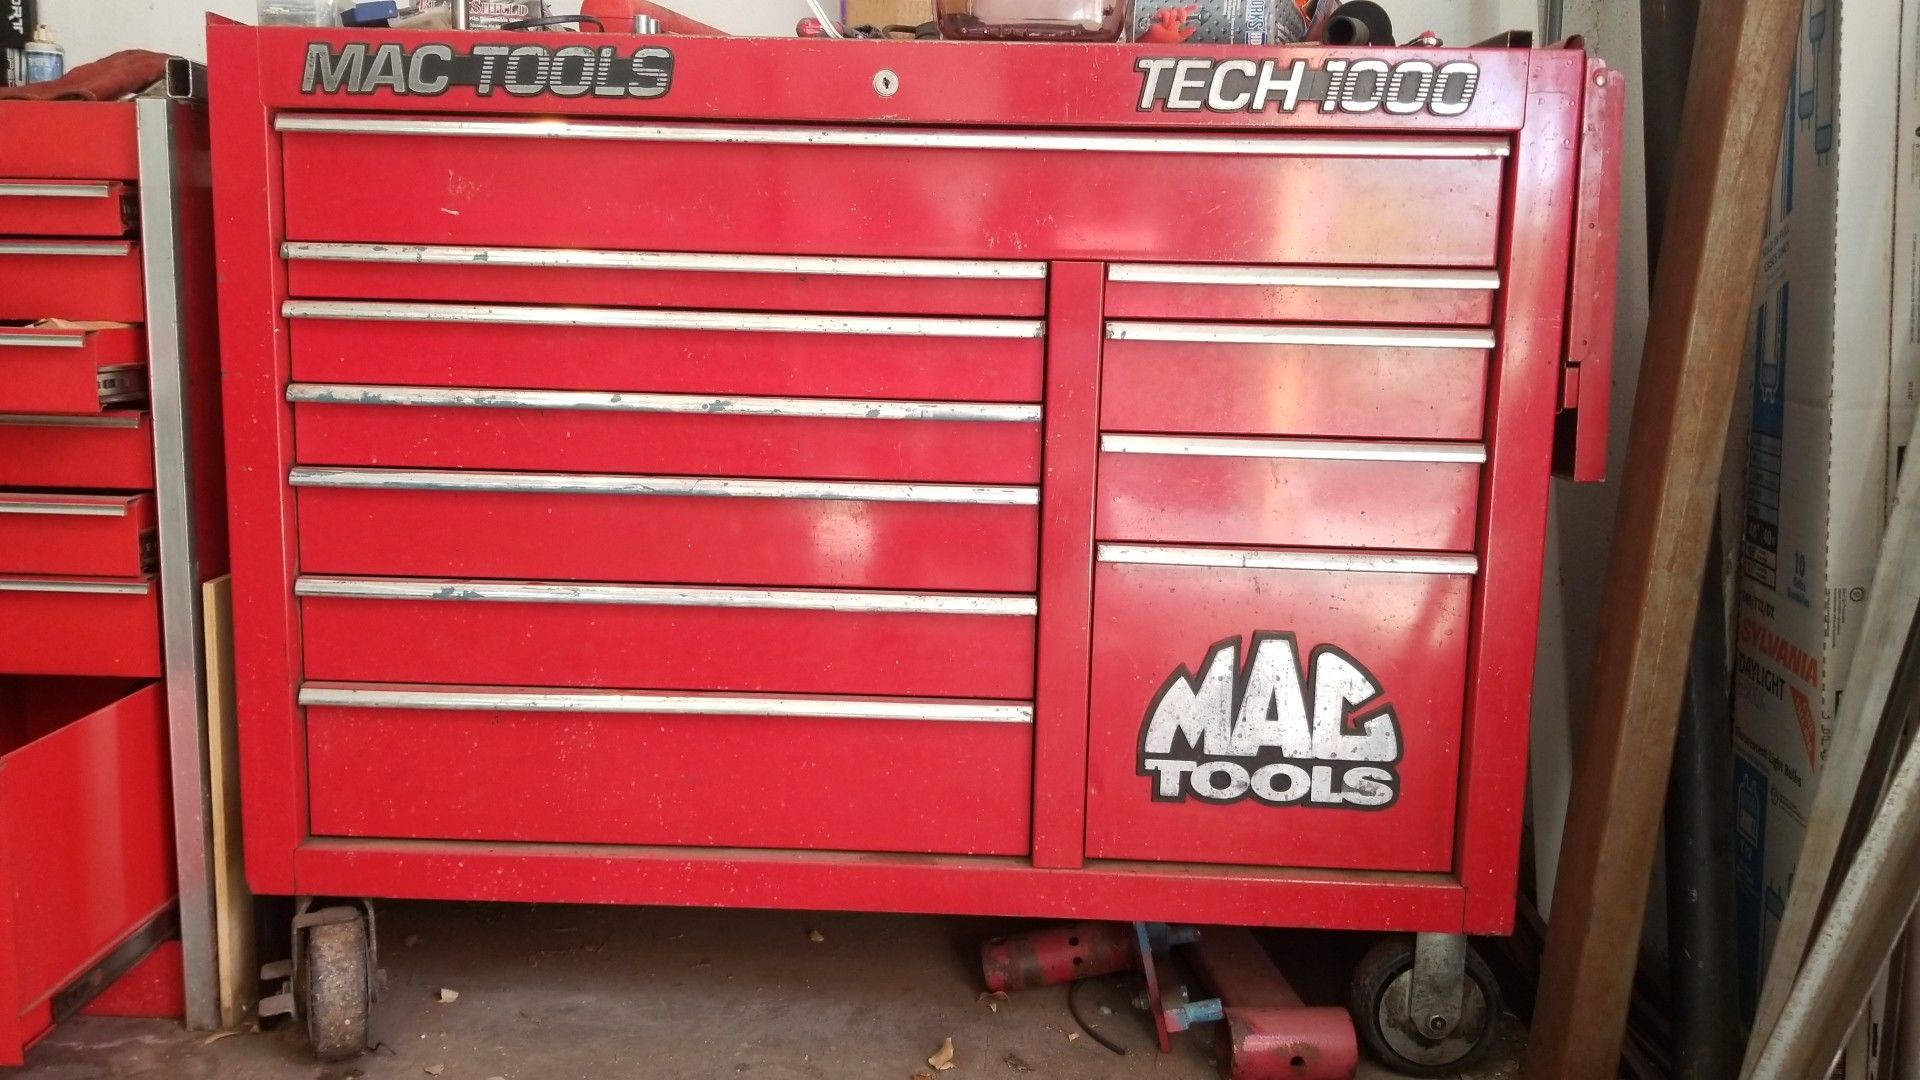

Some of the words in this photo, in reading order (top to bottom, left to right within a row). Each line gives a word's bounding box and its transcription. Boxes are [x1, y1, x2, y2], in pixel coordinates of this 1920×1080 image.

[302, 43, 453, 93] MAC
[473, 45, 671, 98] TOOLS
[1138, 59, 1306, 111] TECH
[1322, 60, 1480, 115] 1000
[1737, 652, 1785, 701] DAYLIGHT
[1741, 617, 1819, 689] SYLVANIA
[1144, 638, 1398, 762] MAC
[1144, 758, 1394, 806] TOOLS
